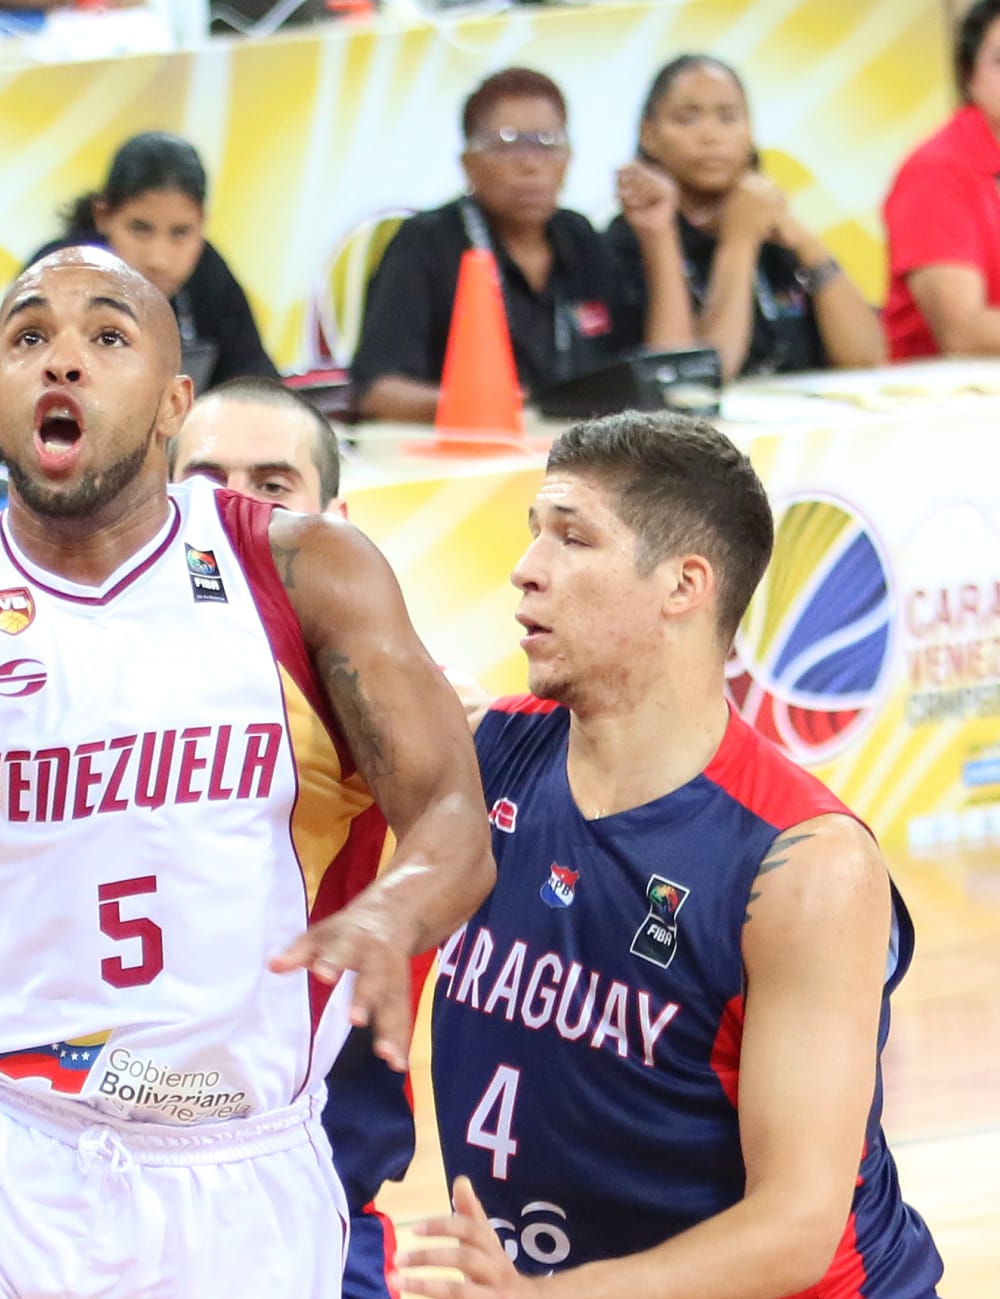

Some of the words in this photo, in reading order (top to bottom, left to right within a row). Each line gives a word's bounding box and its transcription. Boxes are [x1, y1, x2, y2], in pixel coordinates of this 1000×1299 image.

[97, 874, 164, 989] 5
[646, 923, 673, 946] FIBA
[436, 922, 681, 1068] ARAGUAY
[98, 1070, 246, 1110] Bolivariano
[108, 1047, 220, 1089] Gobierno
[466, 1064, 521, 1181] 4
